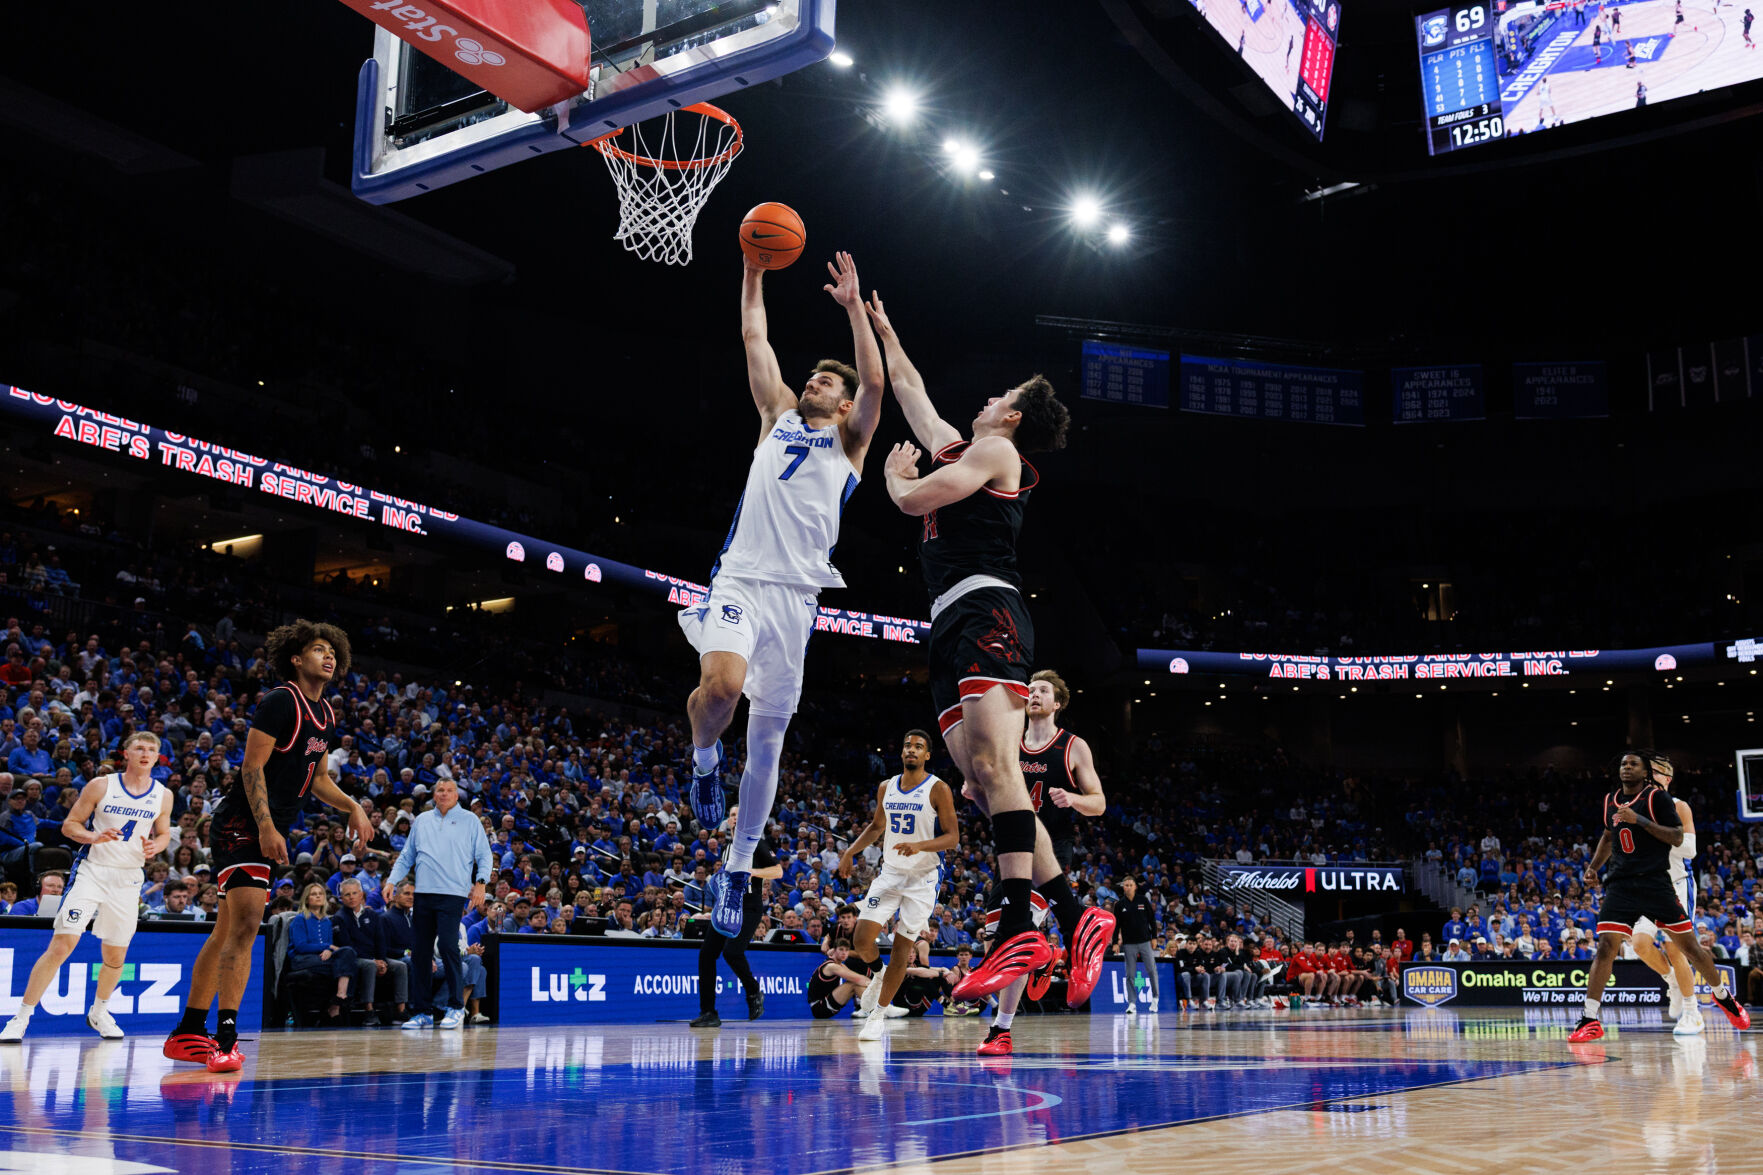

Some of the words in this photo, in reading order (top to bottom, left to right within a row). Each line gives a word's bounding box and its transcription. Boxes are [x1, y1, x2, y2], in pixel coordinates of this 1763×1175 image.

[1455, 6, 1485, 32] 69
[1427, 53, 1444, 64] PLR
[1449, 48, 1465, 60] PTS
[1469, 42, 1485, 54] FLS
[1433, 66, 1439, 74] 4
[1501, 31, 1579, 101] CREIGHTON
[1435, 75, 1440, 84] 7
[1437, 113, 1455, 125] TEAM
[1455, 109, 1474, 121] FOULS
[1482, 104, 1488, 115] 3
[1452, 117, 1503, 146] 12:50
[1404, 378, 1471, 389] APPEARANCES
[1414, 370, 1445, 380] SWEET
[1525, 375, 1595, 384] APPEARANCES
[778, 445, 810, 481] 7
[54, 415, 150, 459] ABE'S
[158, 441, 254, 488] TRASH
[382, 505, 427, 536] INC.
[883, 624, 920, 644] INC.
[1269, 663, 1330, 680] ABE'S
[1335, 663, 1409, 680] TRASH
[1524, 660, 1569, 676] INC.
[298, 761, 316, 797] 1
[104, 805, 155, 819] CREIGHTON
[885, 802, 923, 812] CREIGHTON
[117, 820, 138, 842] 4
[890, 813, 915, 834] 53
[1619, 828, 1635, 853] 0
[1222, 870, 1301, 891] Michelob
[531, 966, 606, 1002] Lutz
[634, 975, 723, 994] ACCOUNTG
[1408, 971, 1453, 987] OMAHA
[1461, 969, 1527, 988] Omaha
[1531, 969, 1565, 988] Car
[1408, 986, 1427, 994] CAR
[1429, 986, 1453, 994] CARE
[1523, 991, 1549, 1003] We'll
[1551, 991, 1565, 1003] be
[1618, 991, 1636, 1003] the
[1639, 991, 1661, 1003] ride
